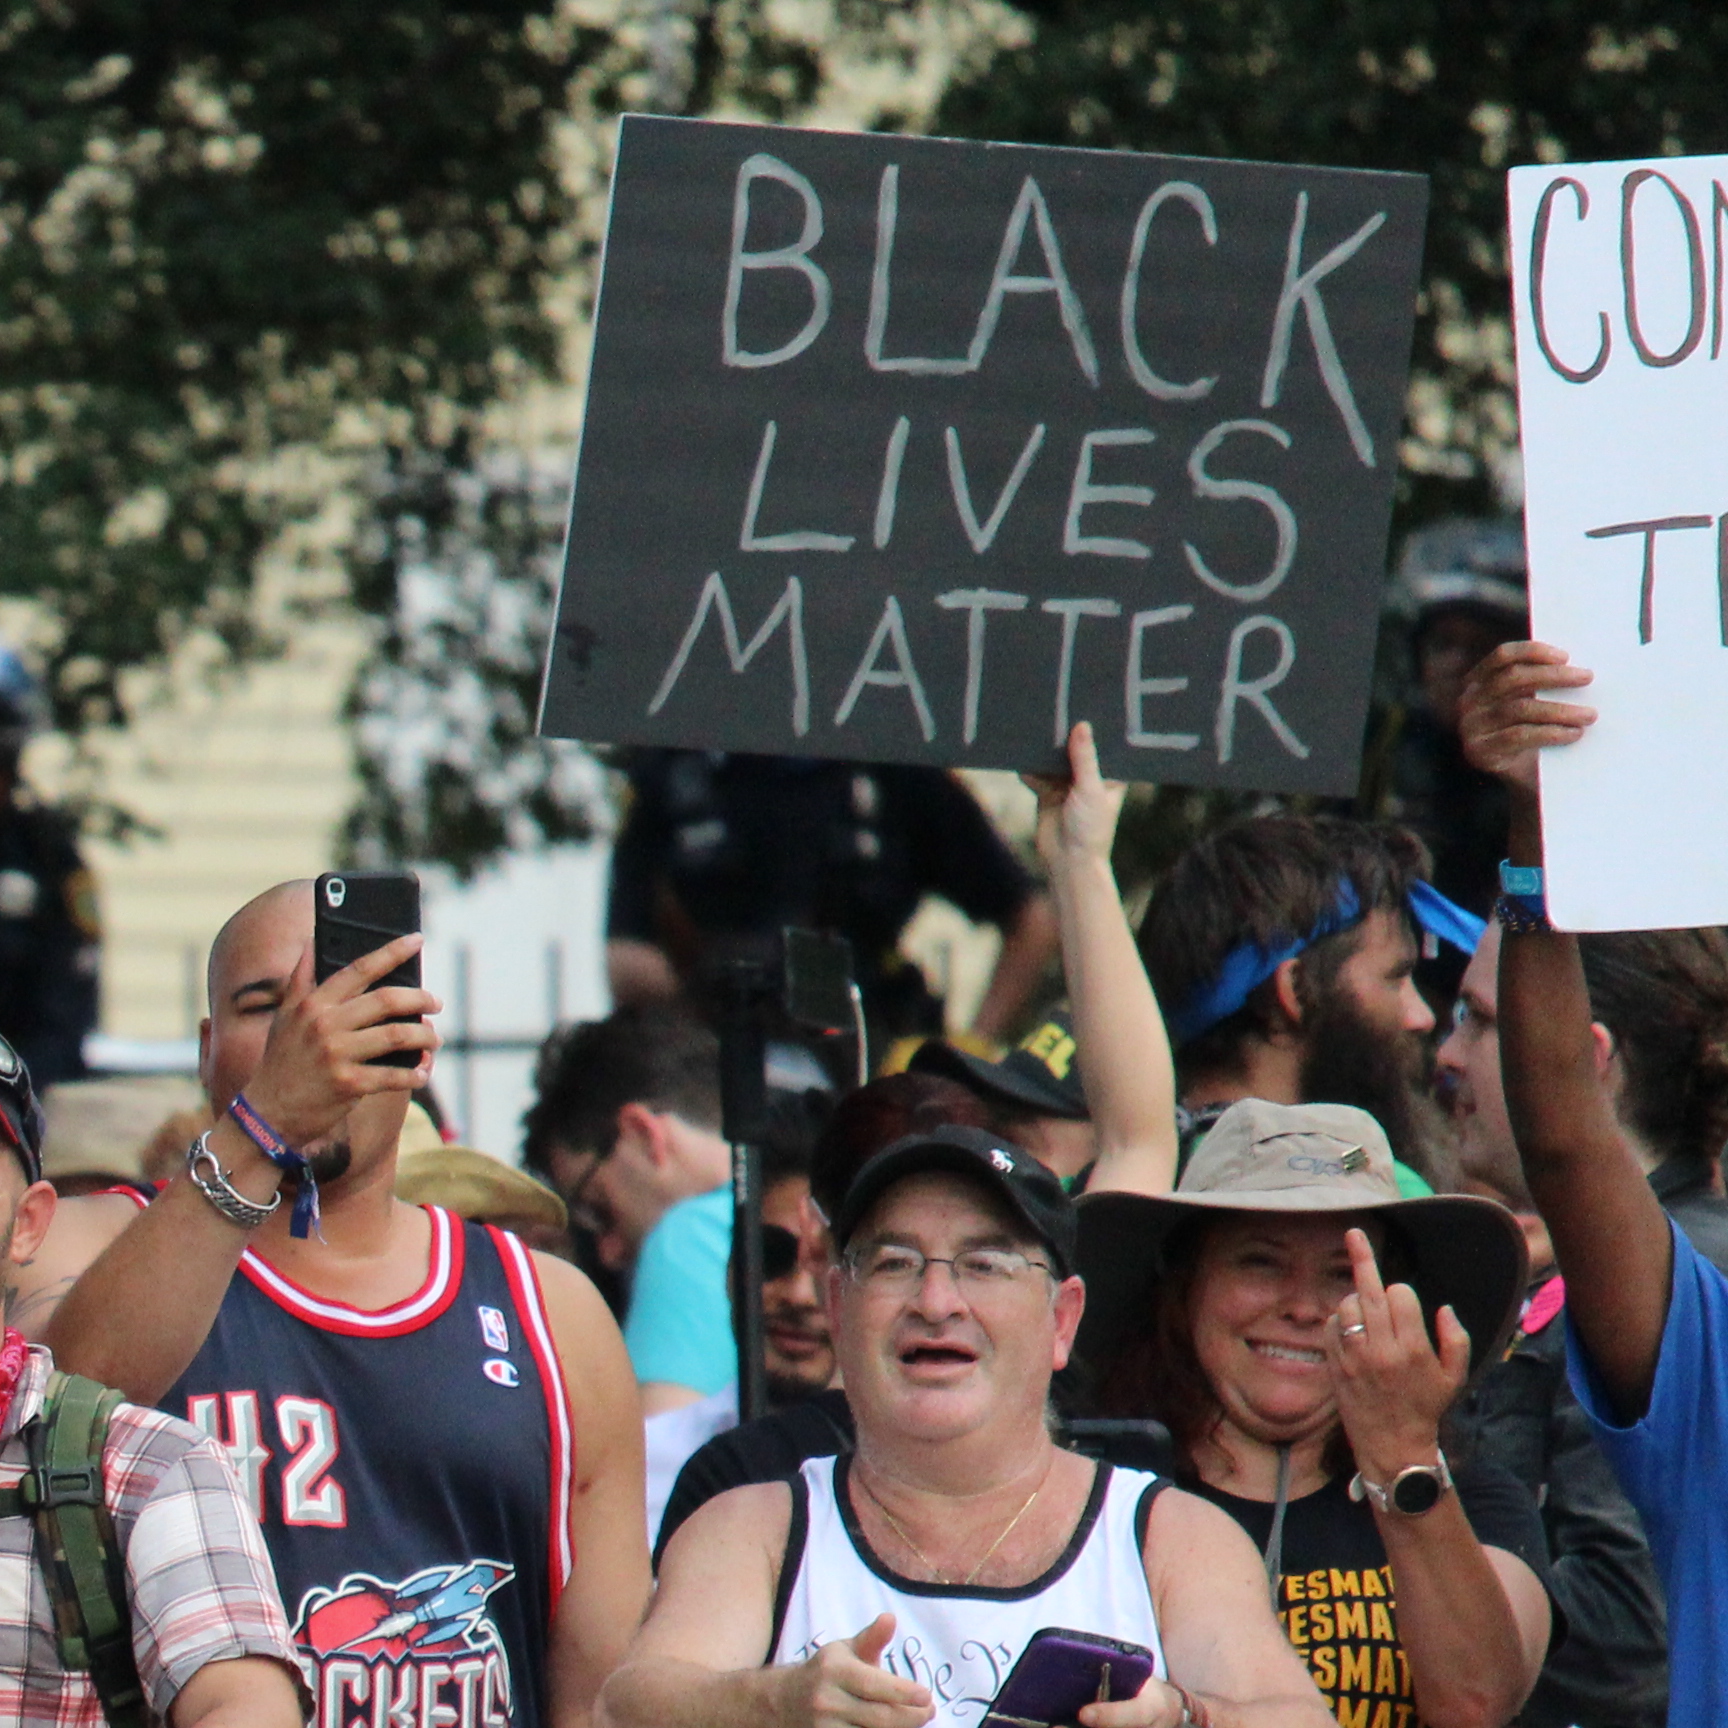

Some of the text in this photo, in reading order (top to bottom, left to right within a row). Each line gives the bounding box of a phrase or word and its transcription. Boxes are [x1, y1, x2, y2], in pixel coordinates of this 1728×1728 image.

[721, 152, 1387, 468] BLACK
[740, 415, 1298, 602] LIVES
[647, 571, 1311, 764] MATTER
[187, 1389, 348, 1530] 42
